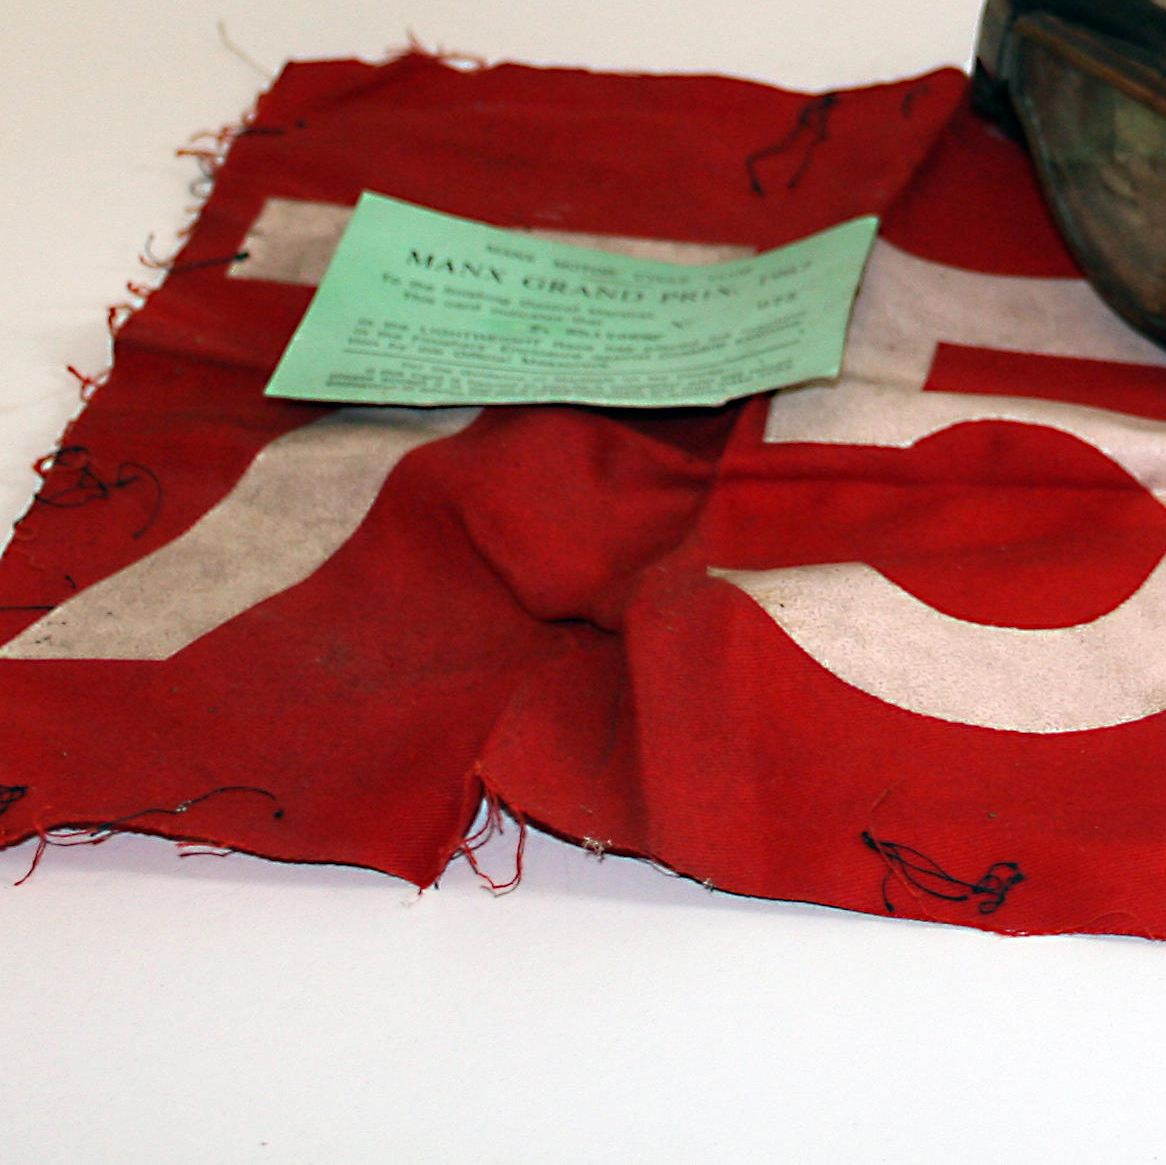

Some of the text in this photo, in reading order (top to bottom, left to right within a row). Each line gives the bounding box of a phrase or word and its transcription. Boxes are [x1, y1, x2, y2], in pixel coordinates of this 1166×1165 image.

[407, 250, 506, 284] MANX
[521, 276, 645, 302] GRAND
[660, 285, 738, 305] PRIX
